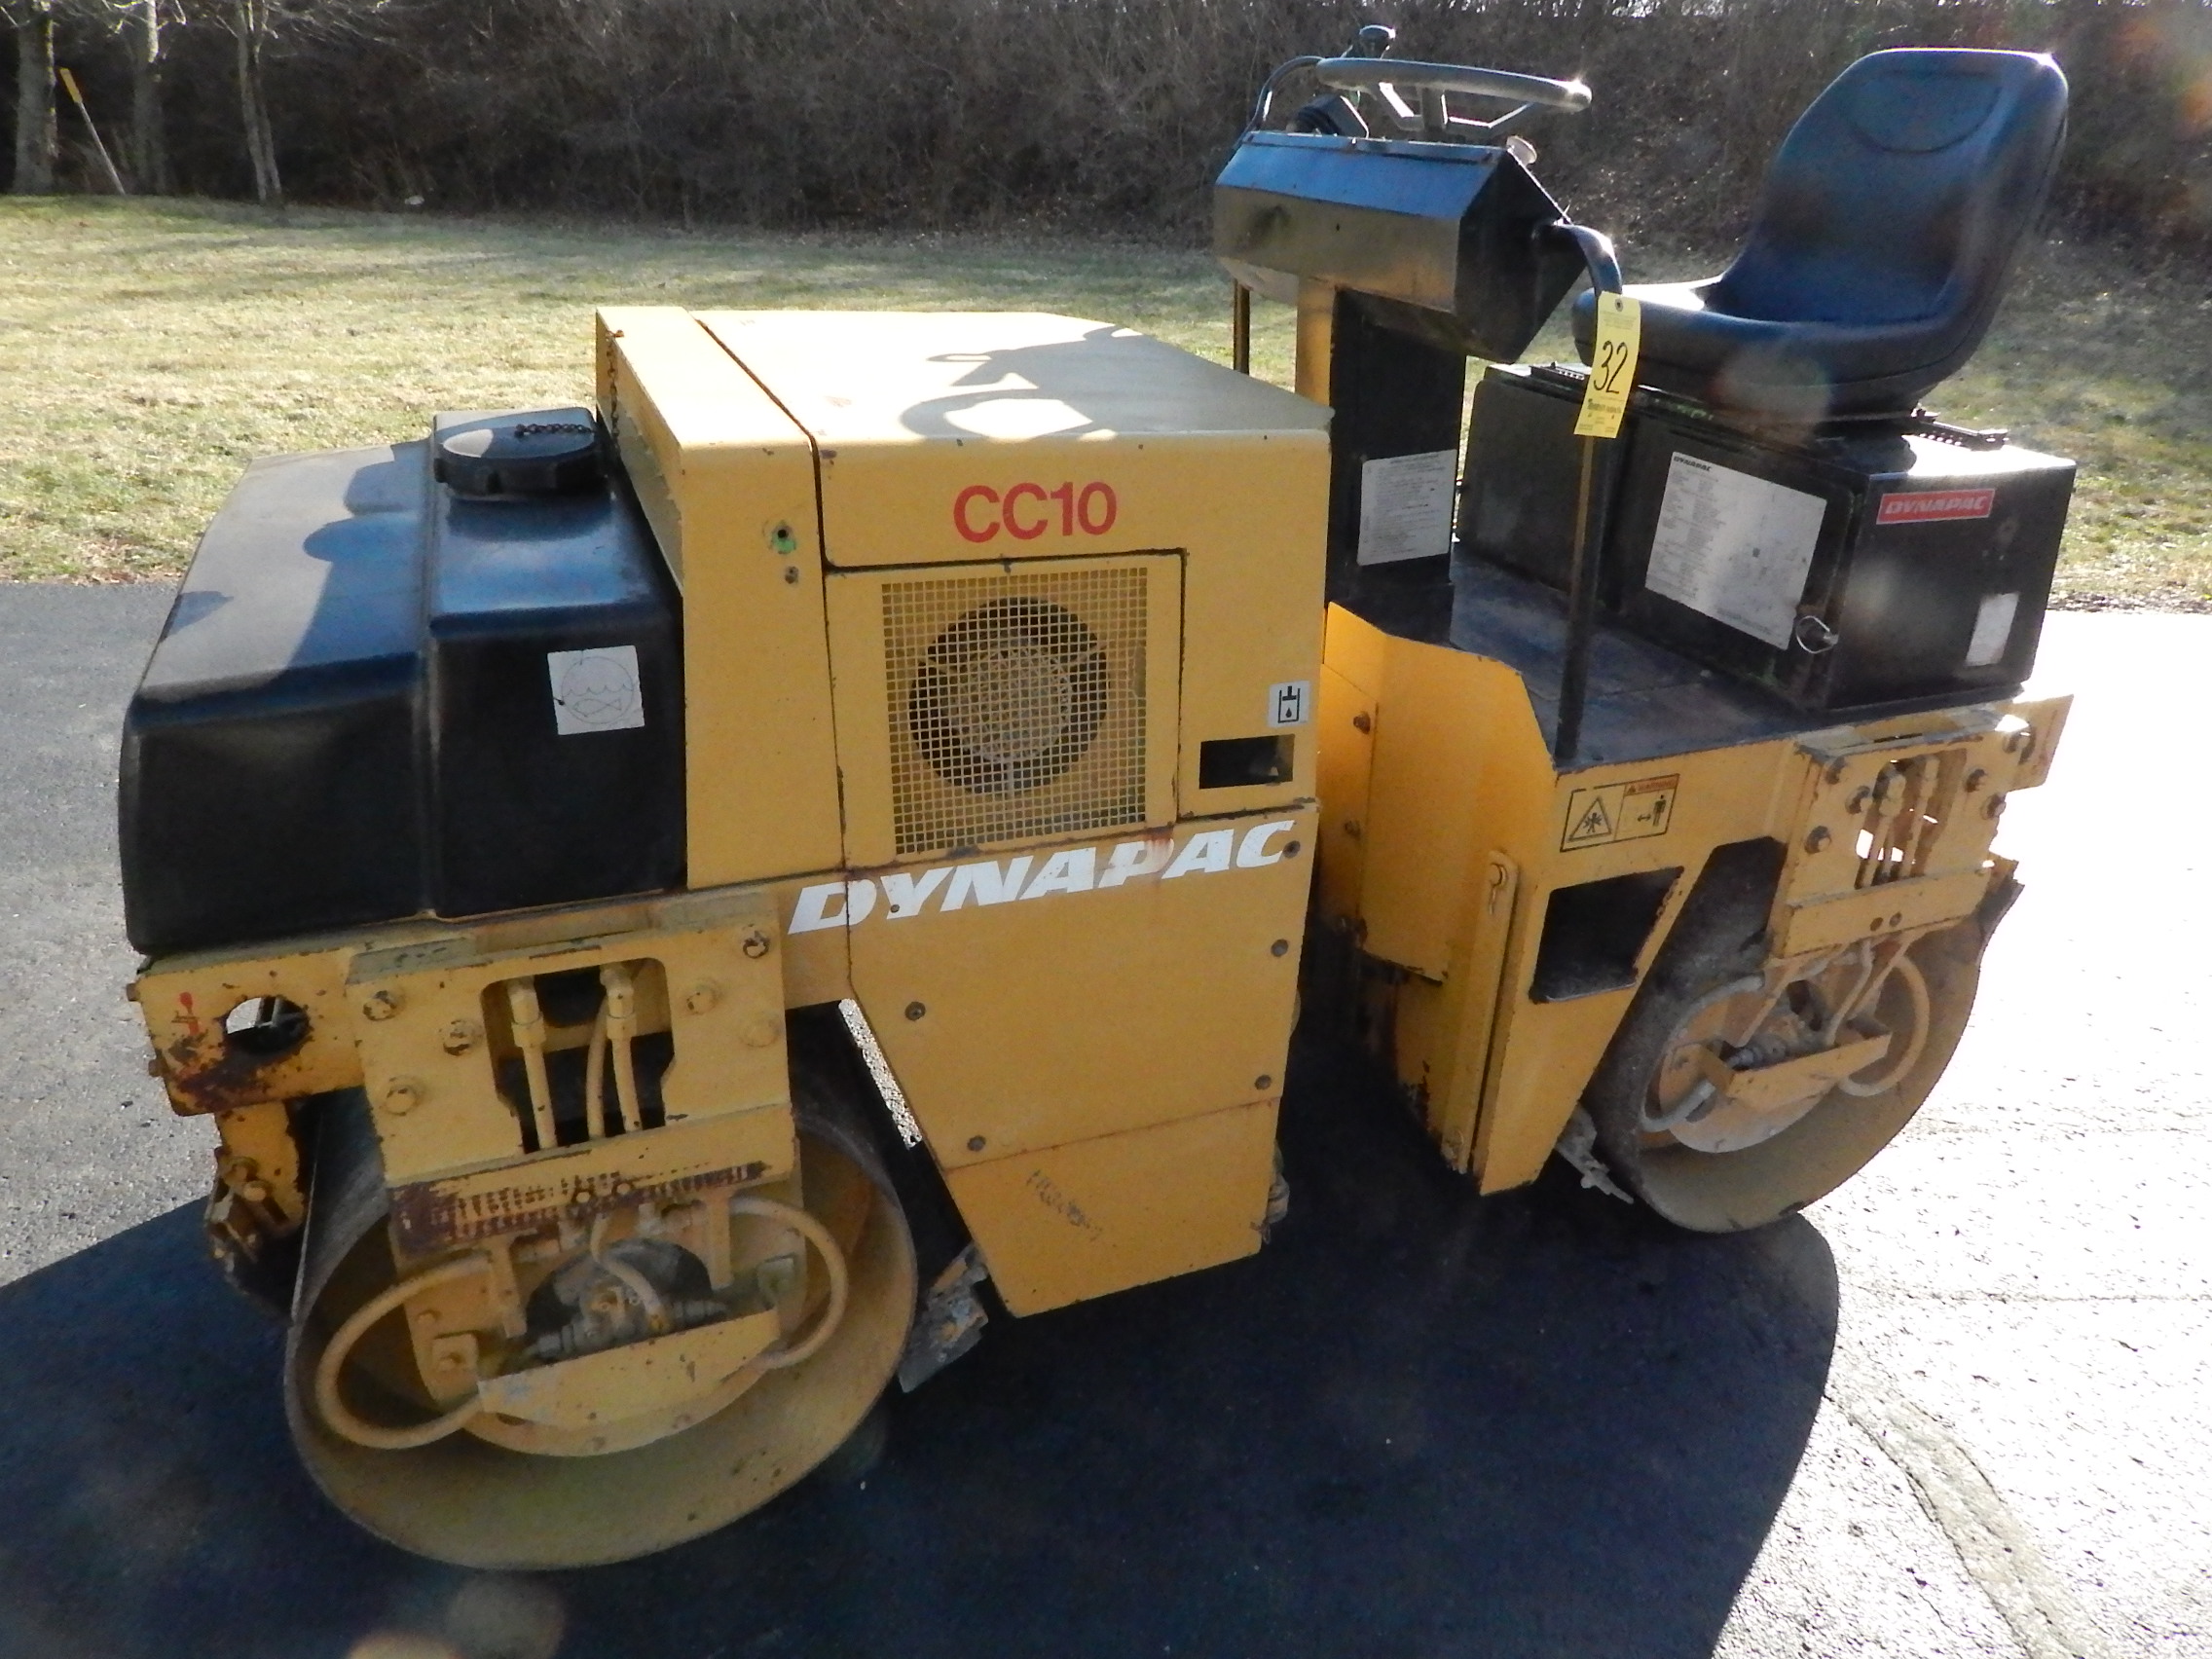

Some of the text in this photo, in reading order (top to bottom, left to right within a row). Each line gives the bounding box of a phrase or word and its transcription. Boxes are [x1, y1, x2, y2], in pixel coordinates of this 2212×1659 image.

[1594, 340, 1628, 393] 32
[953, 481, 1117, 542] CC10
[1884, 496, 1988, 515] DYNAPAC
[788, 820, 1295, 935] DYNAPAC
